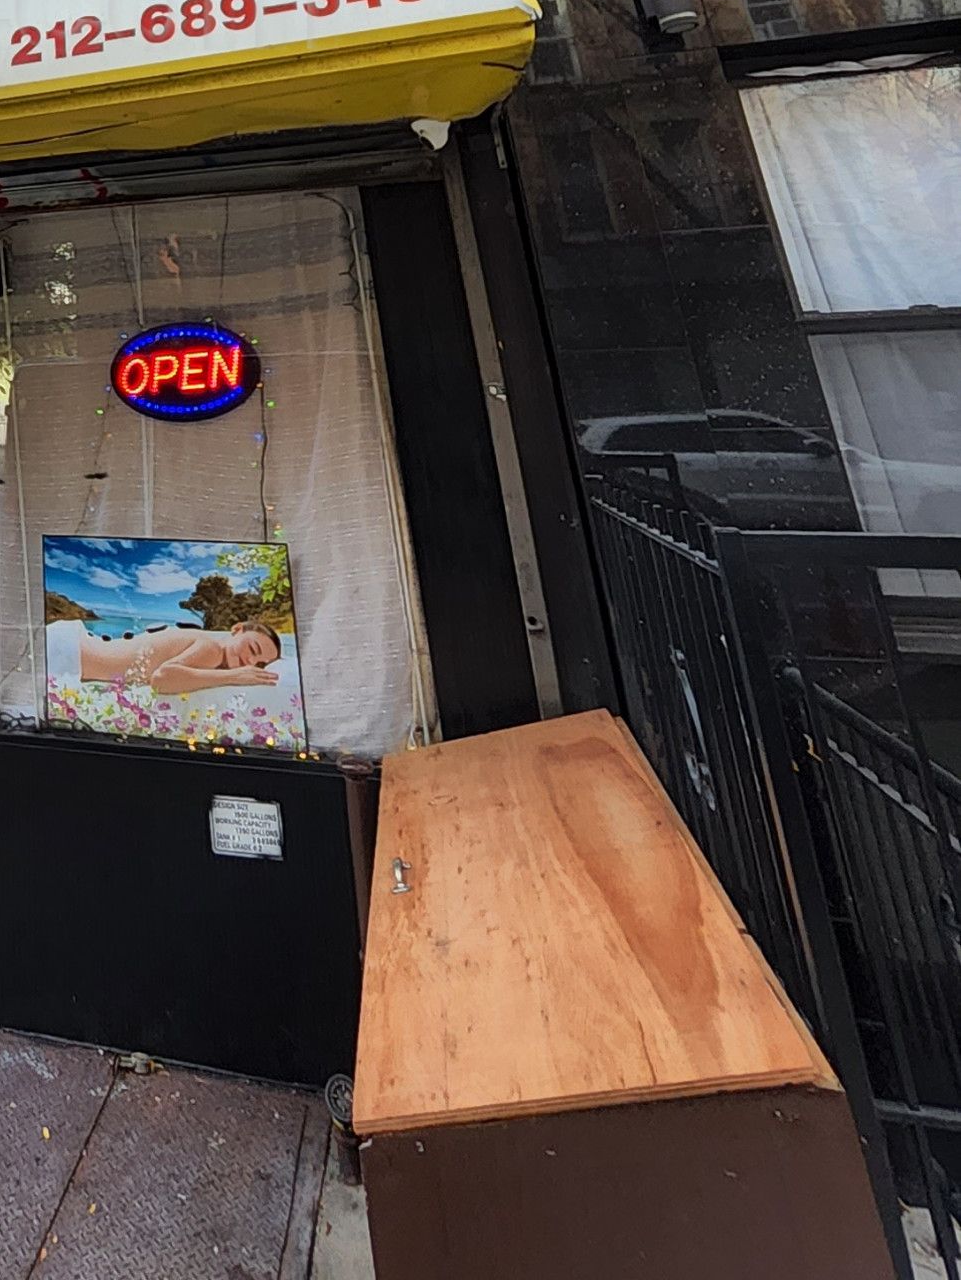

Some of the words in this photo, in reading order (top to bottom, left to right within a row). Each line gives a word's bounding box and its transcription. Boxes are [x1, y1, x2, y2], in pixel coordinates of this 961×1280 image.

[119, 345, 242, 396] OPEN
[213, 801, 236, 810] DESIGN
[249, 813, 277, 822] GALLONS
[215, 818, 242, 826] WORKING
[243, 820, 272, 828] CAPACITY
[251, 829, 278, 838] GALLONS
